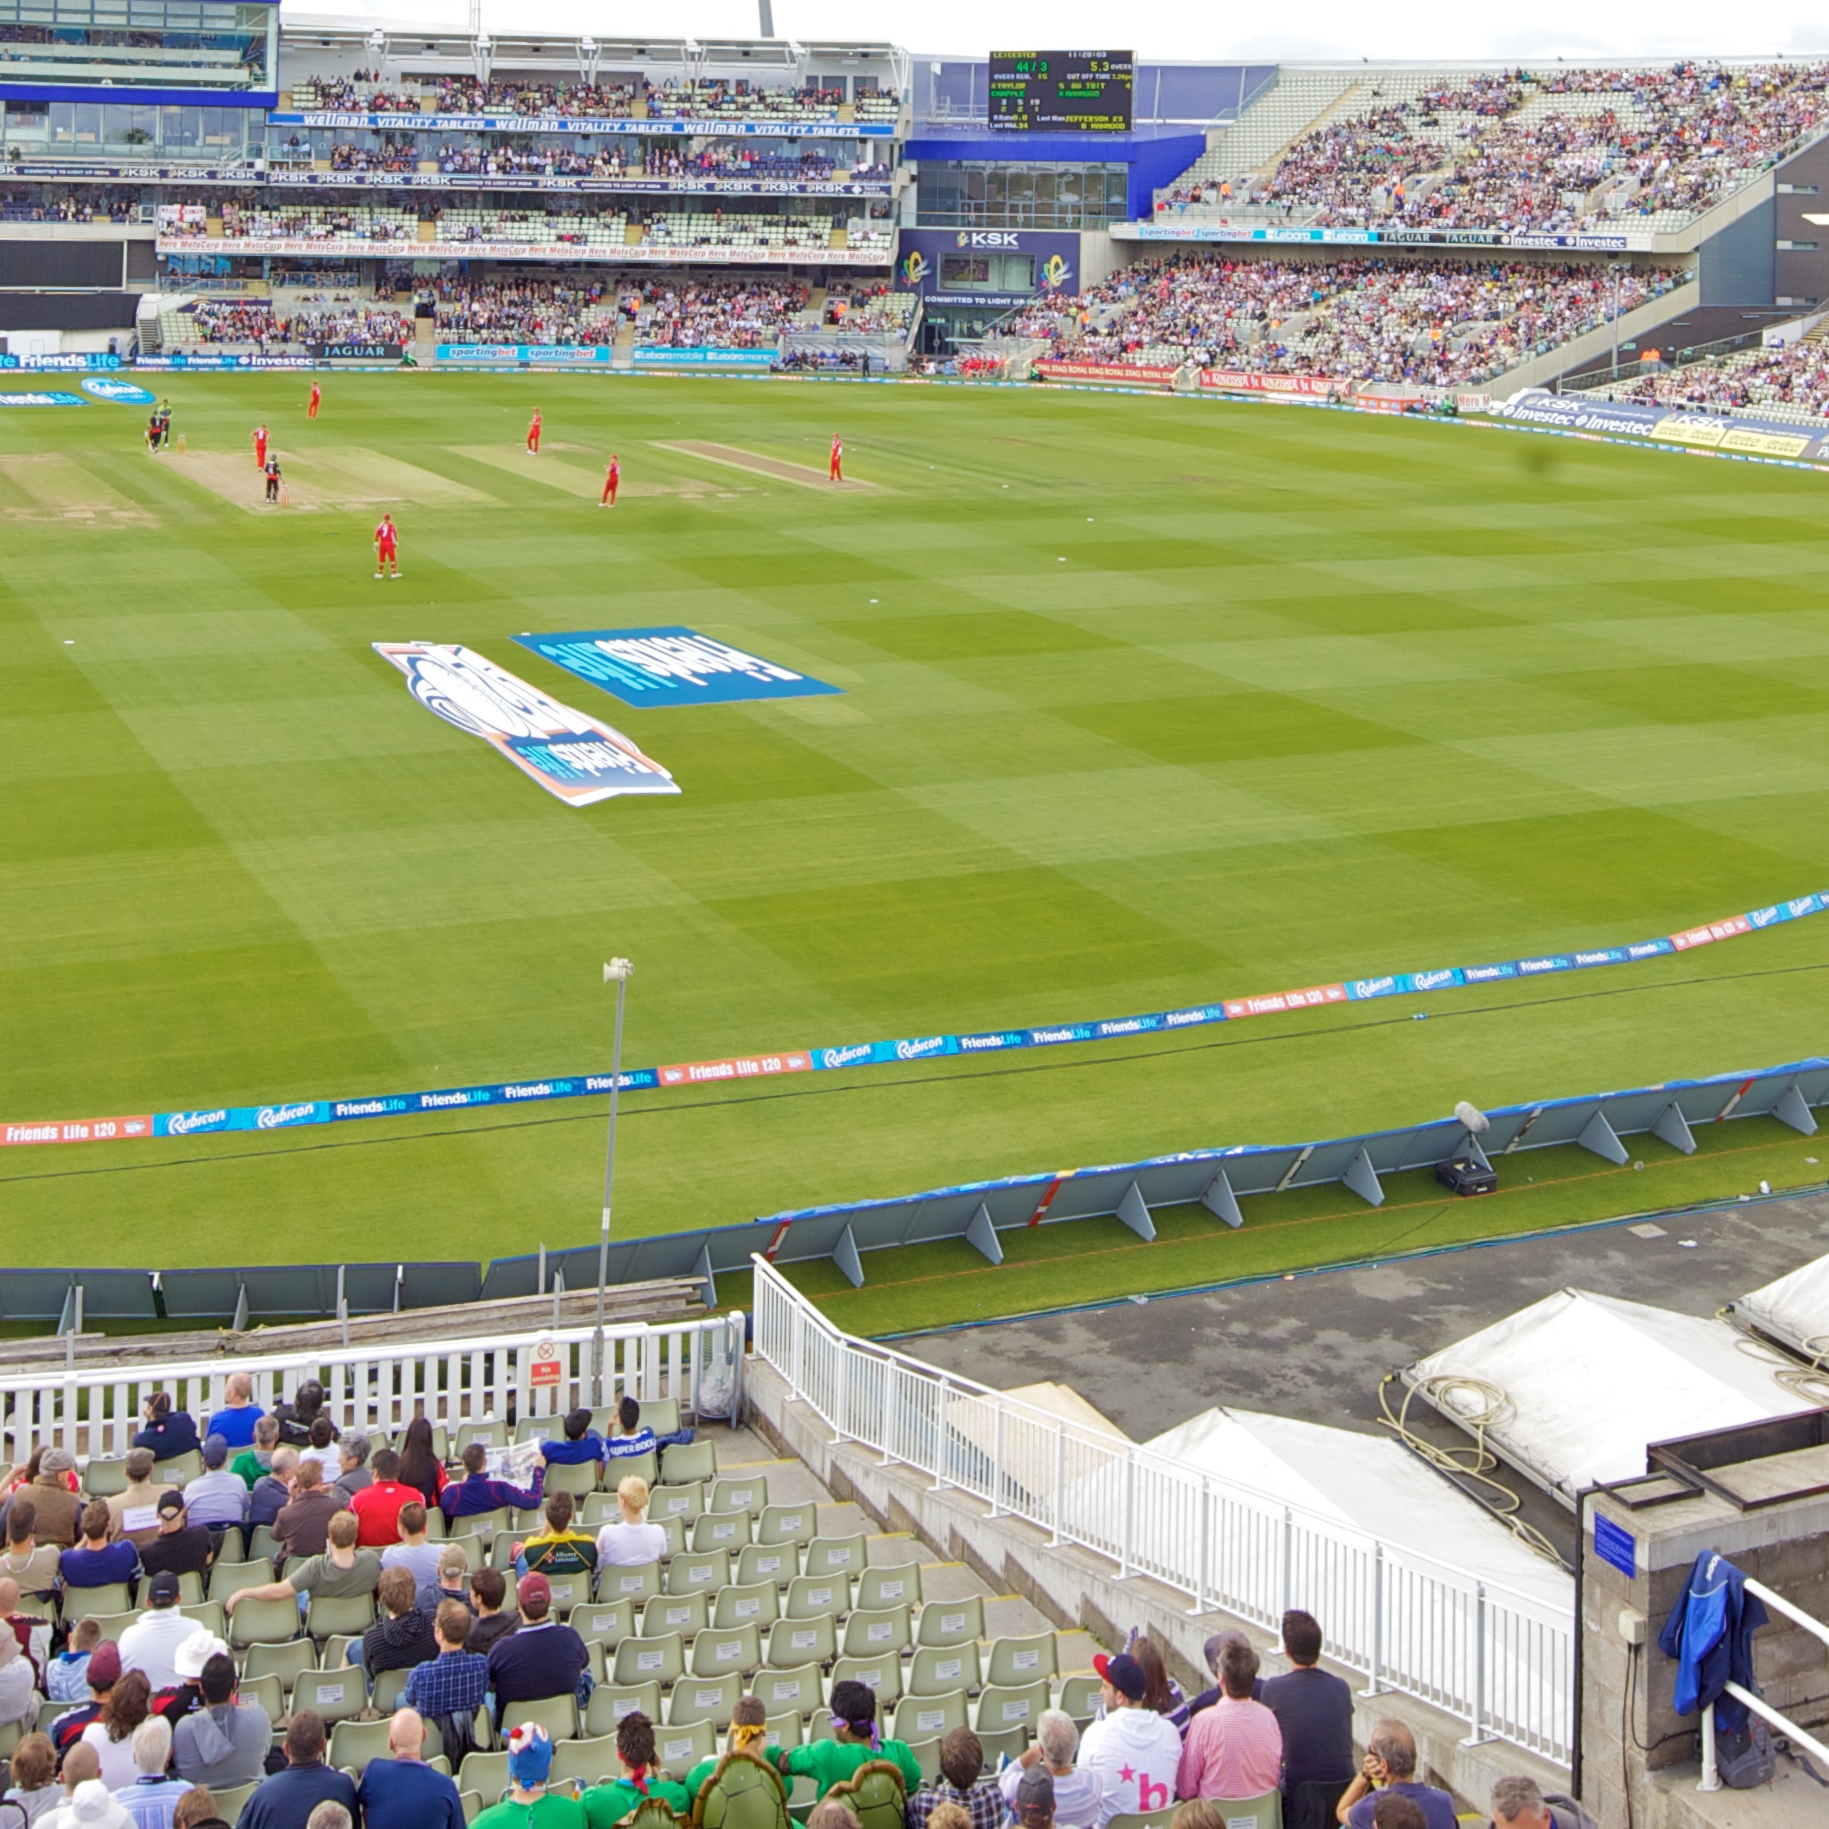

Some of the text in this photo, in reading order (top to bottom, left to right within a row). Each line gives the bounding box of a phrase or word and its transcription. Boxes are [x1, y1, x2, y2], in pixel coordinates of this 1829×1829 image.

[377, 117, 431, 128] VITALITY
[435, 120, 485, 130] TABLETS
[754, 124, 808, 135] VITALITY
[812, 126, 860, 136] TABLETS
[972, 233, 1019, 245] KSK
[1384, 233, 1430, 241] JAGUAR
[1446, 235, 1494, 244] JAGUAR
[1511, 235, 1558, 246] Investec
[925, 295, 973, 304] COMMITTED
[987, 297, 1011, 305] LIGHT
[325, 346, 385, 356] JAGUAR
[450, 347, 516, 359] sportingbet
[528, 347, 596, 359] sportingbet
[252, 356, 314, 366] Investec
[1459, 396, 1479, 407] Hero
[1536, 398, 1587, 412] KSK
[1512, 406, 1579, 426] Investec
[1585, 414, 1654, 436] Investec
[1415, 969, 1452, 991] Rubicon
[897, 1036, 944, 1060] Rubicon
[689, 1063, 734, 1081] Friends
[738, 1060, 759, 1077] Life
[506, 1079, 573, 1100] FriendsLife
[337, 1097, 407, 1117] FriendsLife
[168, 1110, 227, 1135] Rubicon
[6, 1121, 117, 1141] Friends Life t20
[610, 1443, 635, 1457] SUPER
